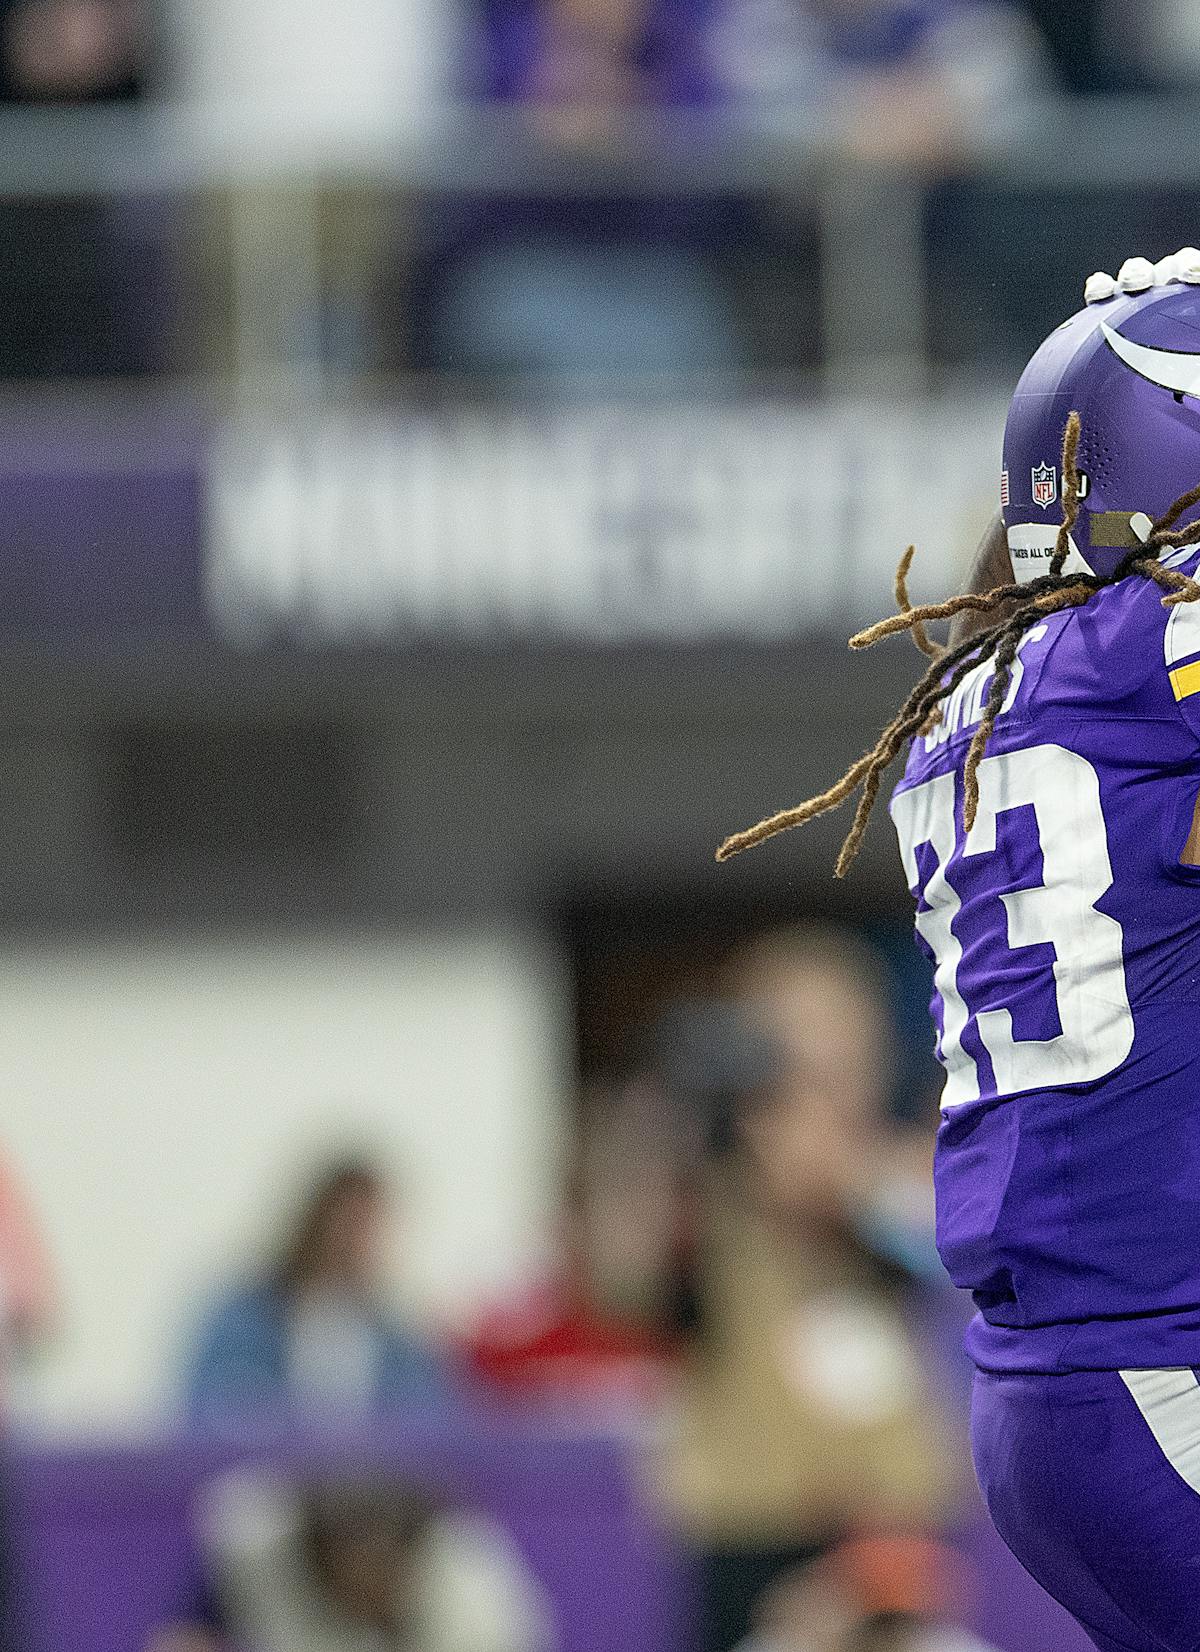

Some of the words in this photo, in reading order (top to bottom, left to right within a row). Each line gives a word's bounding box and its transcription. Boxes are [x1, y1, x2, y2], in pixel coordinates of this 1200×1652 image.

[1034, 483, 1054, 499] NFL
[1030, 548, 1043, 558] ALL
[890, 743, 1136, 1111] 33
